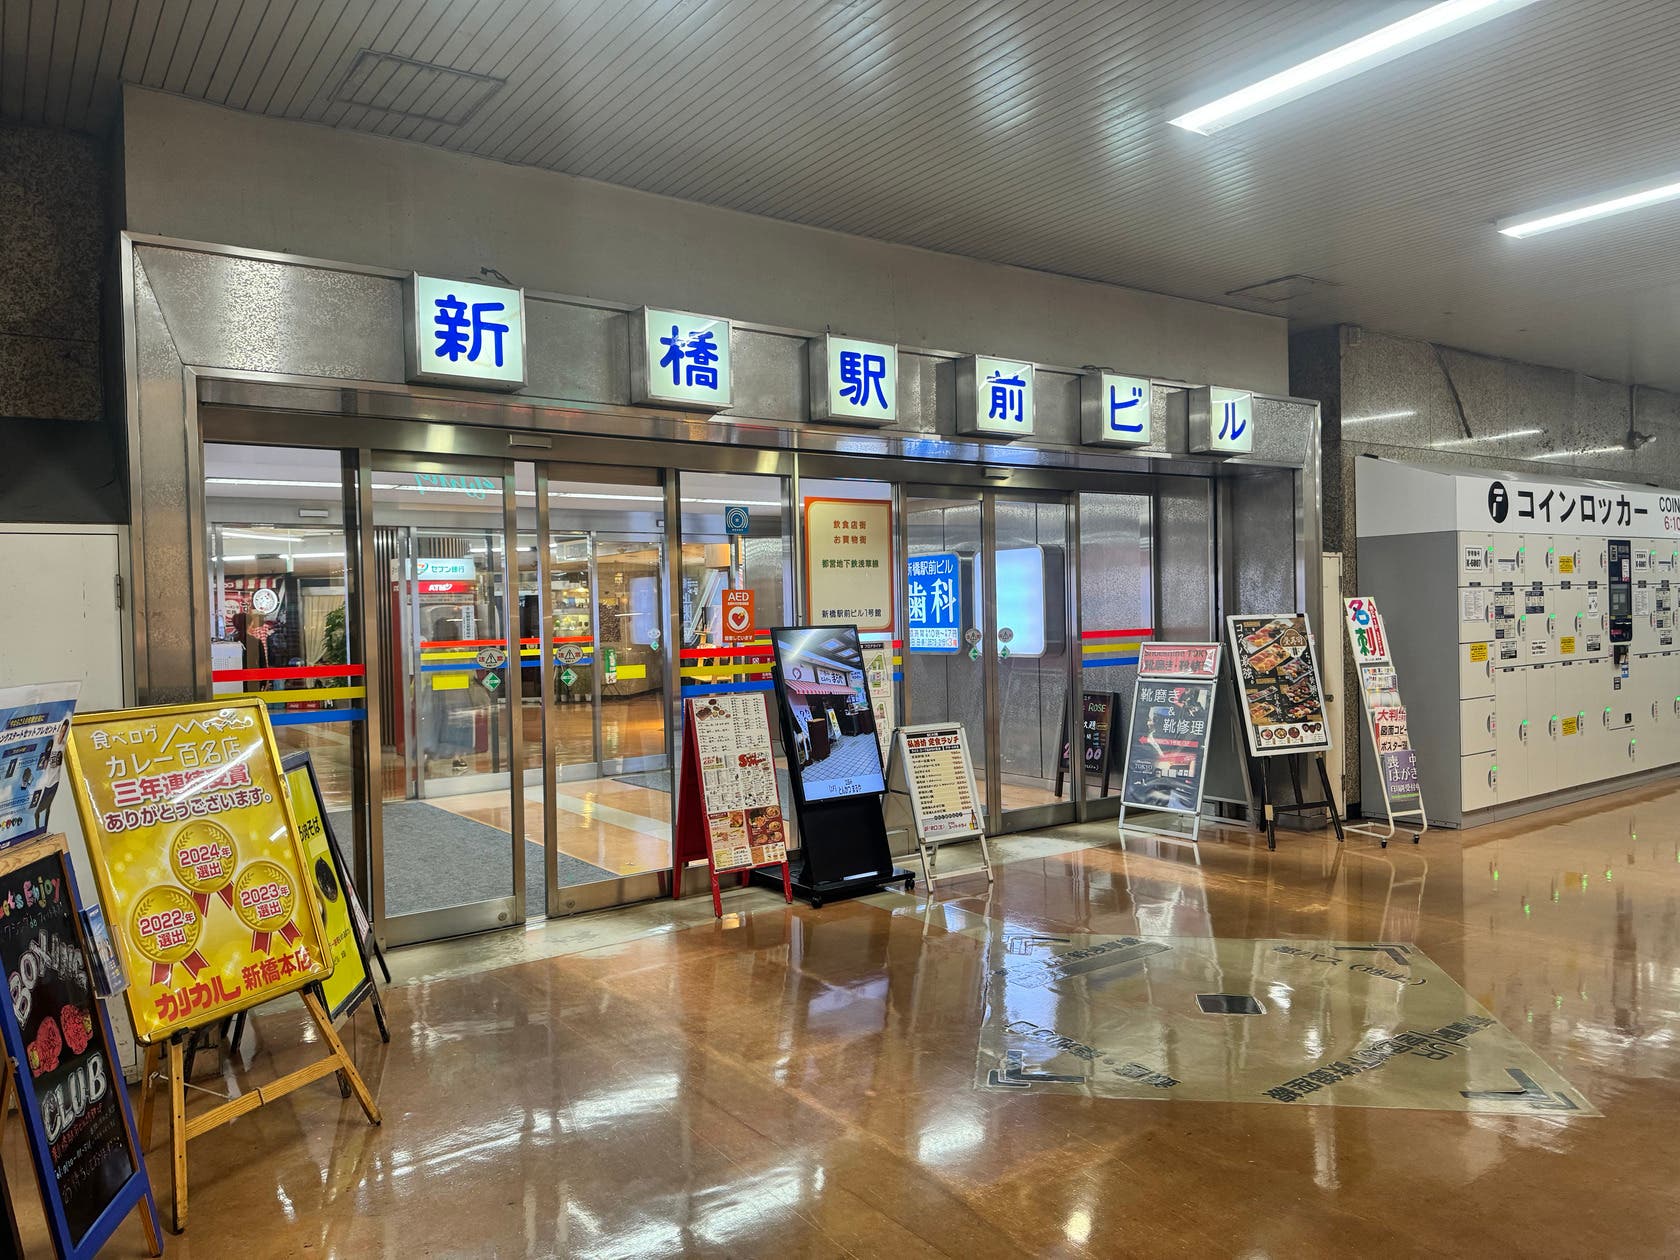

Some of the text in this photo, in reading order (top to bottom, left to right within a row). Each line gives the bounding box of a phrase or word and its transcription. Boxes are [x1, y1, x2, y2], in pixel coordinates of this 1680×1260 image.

[1517, 489, 1648, 527] コインロッカー
[833, 520, 867, 530] 飲食店街
[833, 535, 867, 545] お買物街
[431, 565, 465, 573] セブン銀行
[822, 559, 879, 569] 都営地下鉄浅草線
[428, 584, 450, 592] ATM
[728, 592, 750, 602] AED
[908, 578, 958, 624] 歯科
[822, 608, 882, 618] 新橋駅前ビル1号館
[1349, 599, 1377, 657] 名刺
[1140, 688, 1180, 703] 靴磨き
[1168, 707, 1176, 717] &
[90, 724, 158, 750] 食べログ
[1163, 720, 1205, 736] 靴修理
[1388, 768, 1418, 783] はがき
[104, 787, 272, 833] ありがとうございます。
[179, 844, 232, 867] 2024年
[196, 862, 223, 880] 選出
[240, 883, 290, 907] 2023年
[257, 901, 283, 919] 選出
[139, 909, 196, 936] 2022年
[157, 929, 186, 949] 選出
[154, 944, 313, 1022] カリカル 新橋本店
[41, 1051, 108, 1146] CLUB
